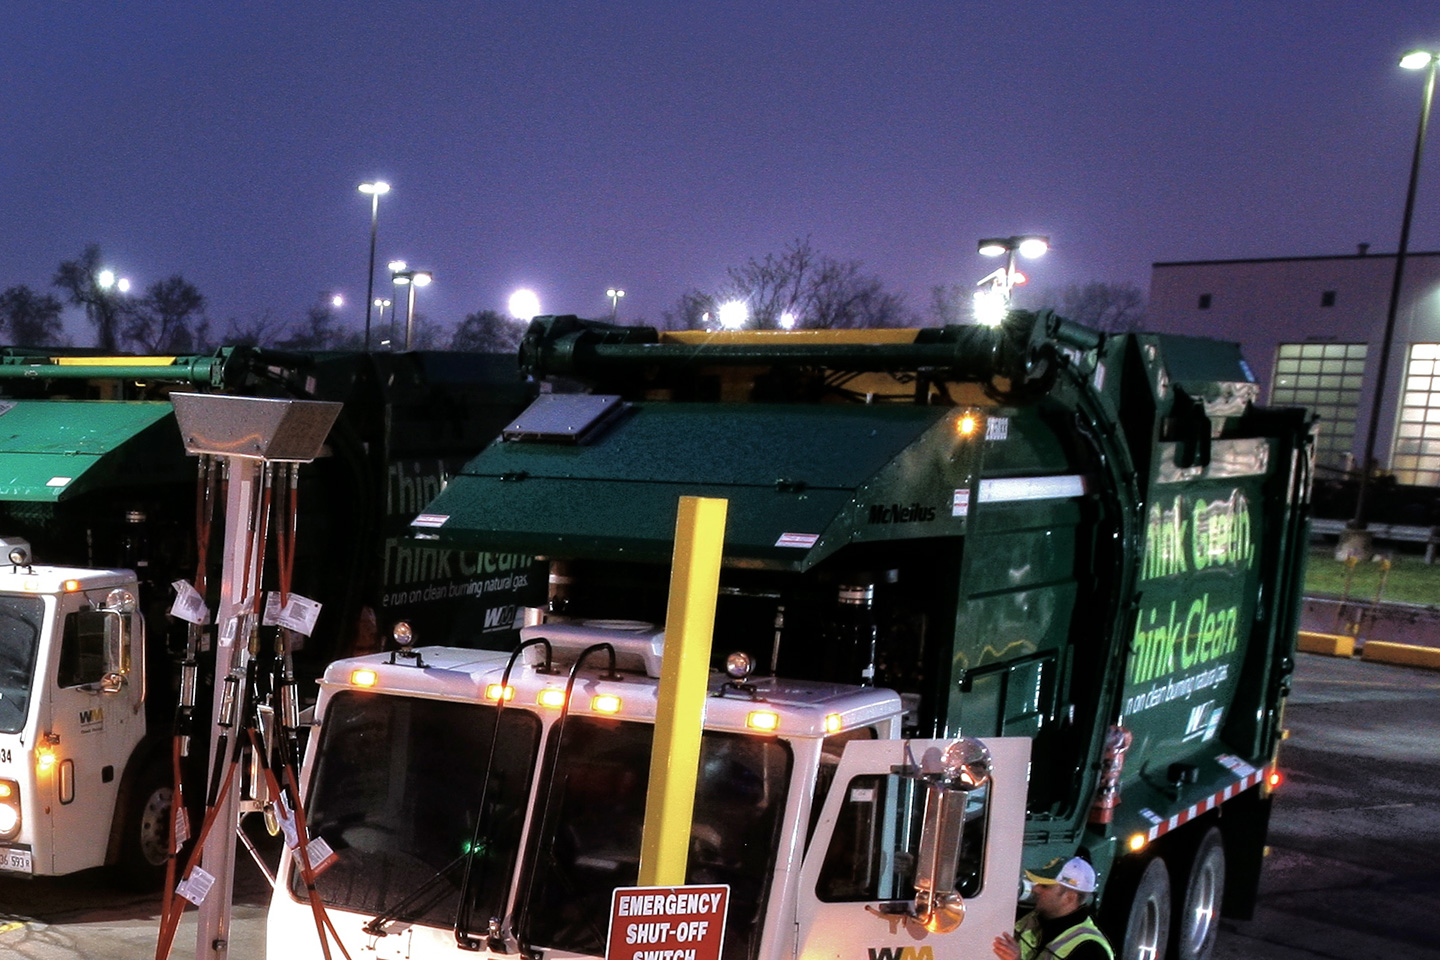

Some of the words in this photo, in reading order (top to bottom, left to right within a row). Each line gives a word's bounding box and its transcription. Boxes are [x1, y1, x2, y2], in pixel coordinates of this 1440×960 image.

[868, 503, 936, 525] McNeilus
[1140, 494, 1188, 581] hink
[384, 537, 452, 587] Think
[382, 593, 390, 607] e
[390, 590, 409, 606] run
[409, 589, 423, 603] on
[423, 583, 448, 601] clean
[448, 578, 483, 598] burning
[483, 572, 513, 593] natural
[1131, 600, 1182, 686] hink
[1181, 592, 1238, 670] Clean.
[618, 892, 722, 917] EMERGENCY
[626, 920, 709, 944] SHUT-OFF
